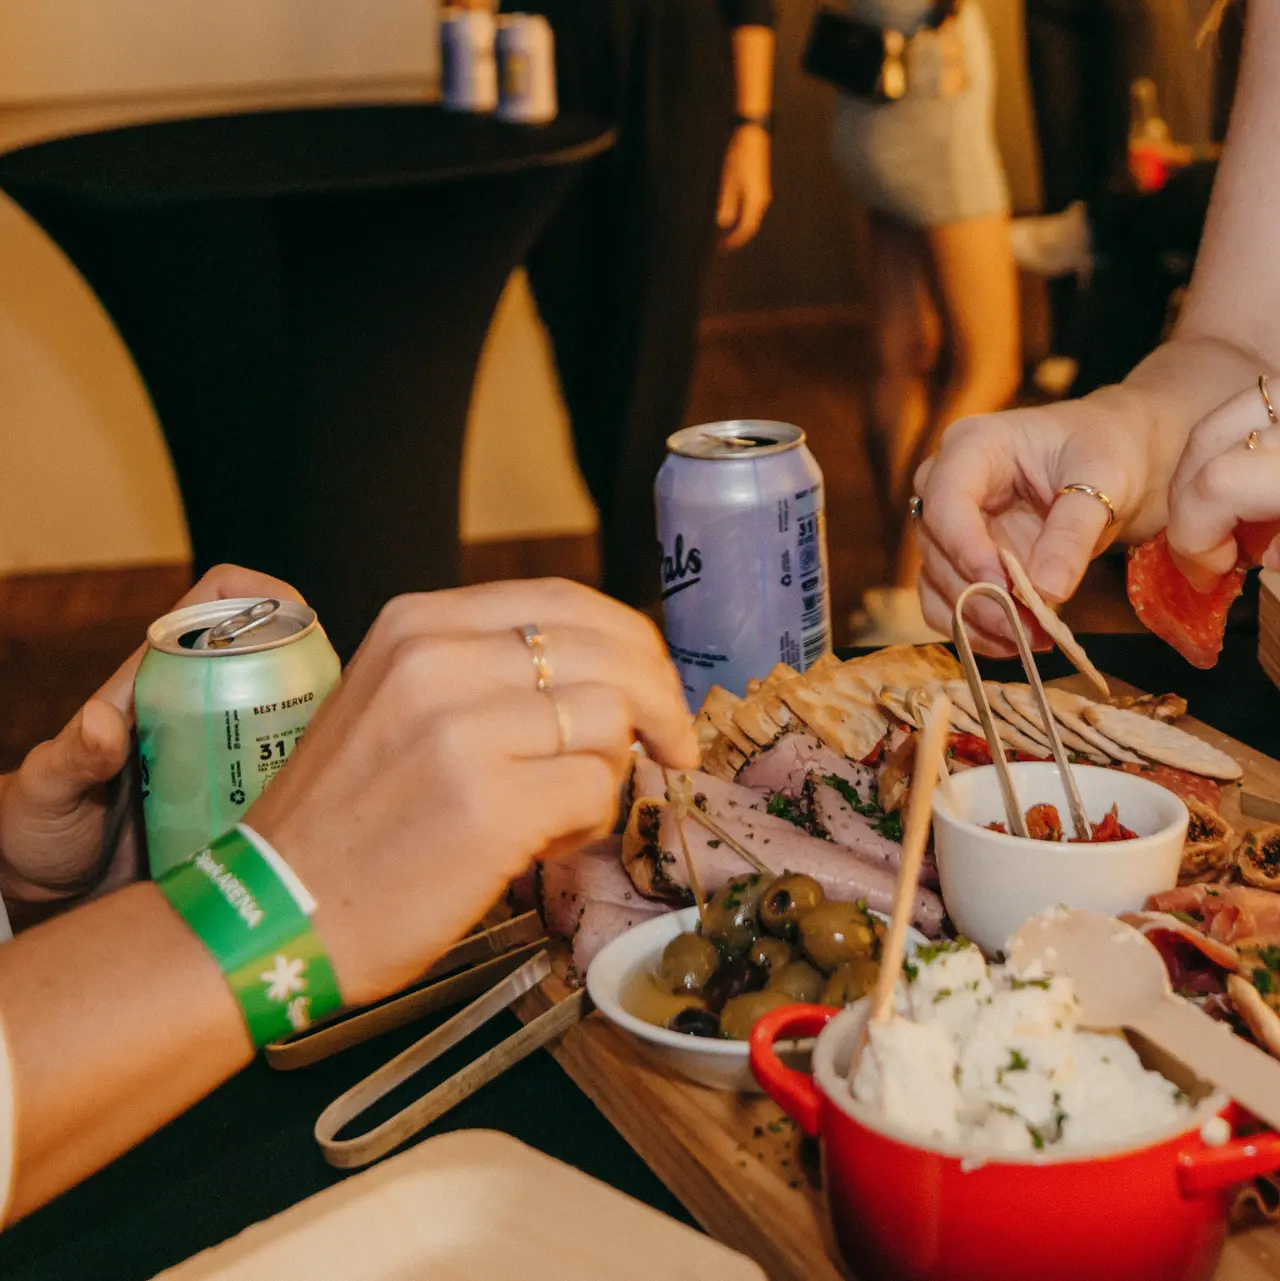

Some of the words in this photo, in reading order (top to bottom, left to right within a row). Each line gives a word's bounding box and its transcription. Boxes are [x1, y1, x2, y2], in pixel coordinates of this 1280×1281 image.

[662, 531, 702, 584] als
[253, 703, 277, 715] BEST
[281, 691, 314, 710] SERVED
[260, 740, 286, 761] 31
